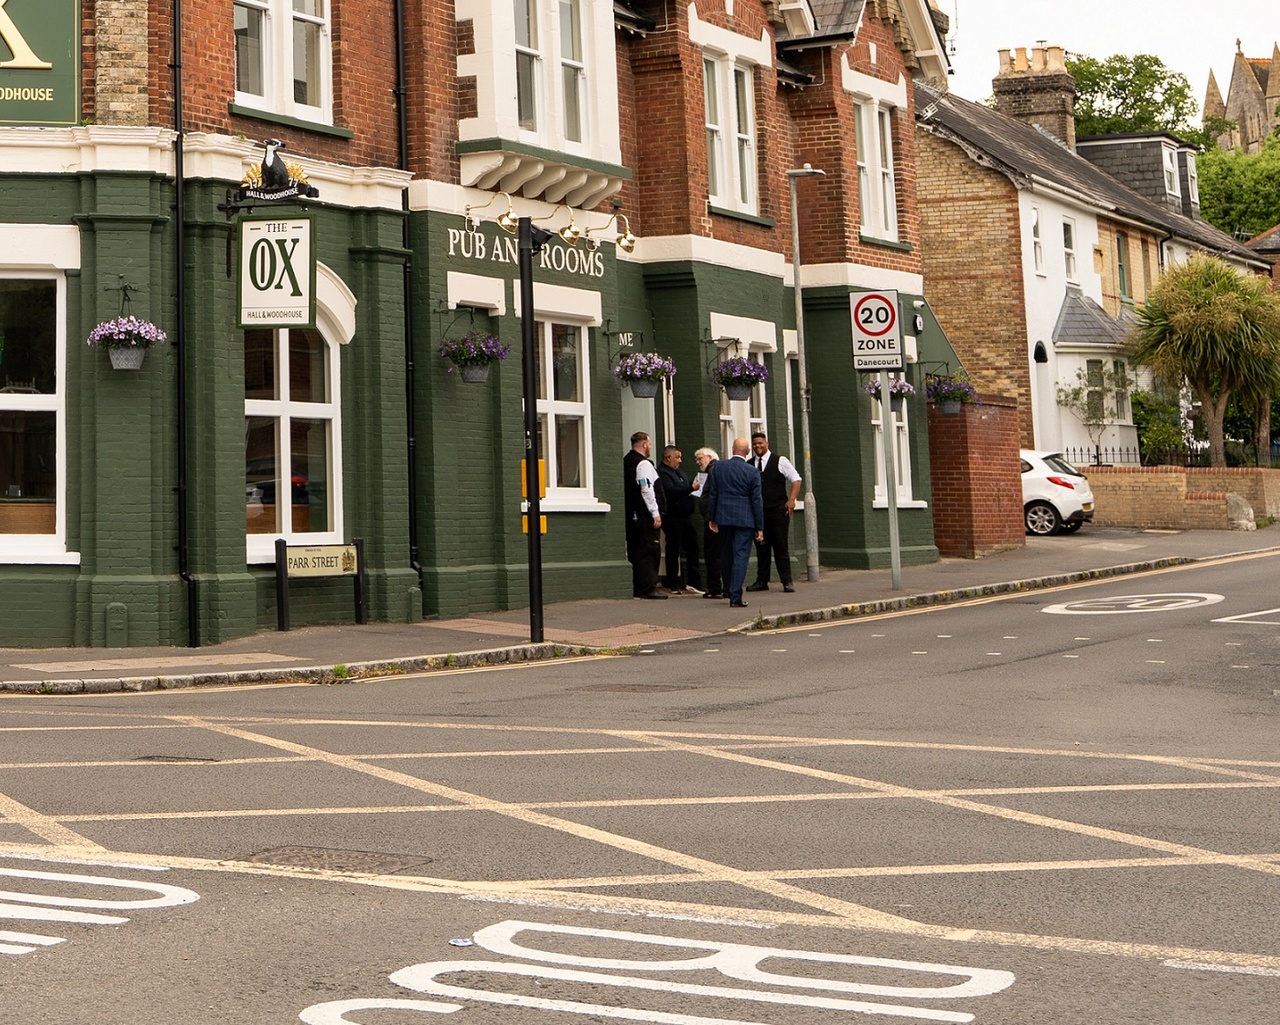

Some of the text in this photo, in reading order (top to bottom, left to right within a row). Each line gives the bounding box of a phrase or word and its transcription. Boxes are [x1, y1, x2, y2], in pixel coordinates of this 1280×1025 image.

[265, 222, 288, 233] THE
[448, 228, 605, 278] PUB AN ROOMS
[249, 238, 303, 297] OX
[247, 310, 303, 319] HALL&WOODHOUSE
[861, 306, 889, 324] 20
[857, 339, 896, 351] ZONE
[857, 358, 899, 367] Danecourt
[288, 556, 339, 569] PARR STREET
